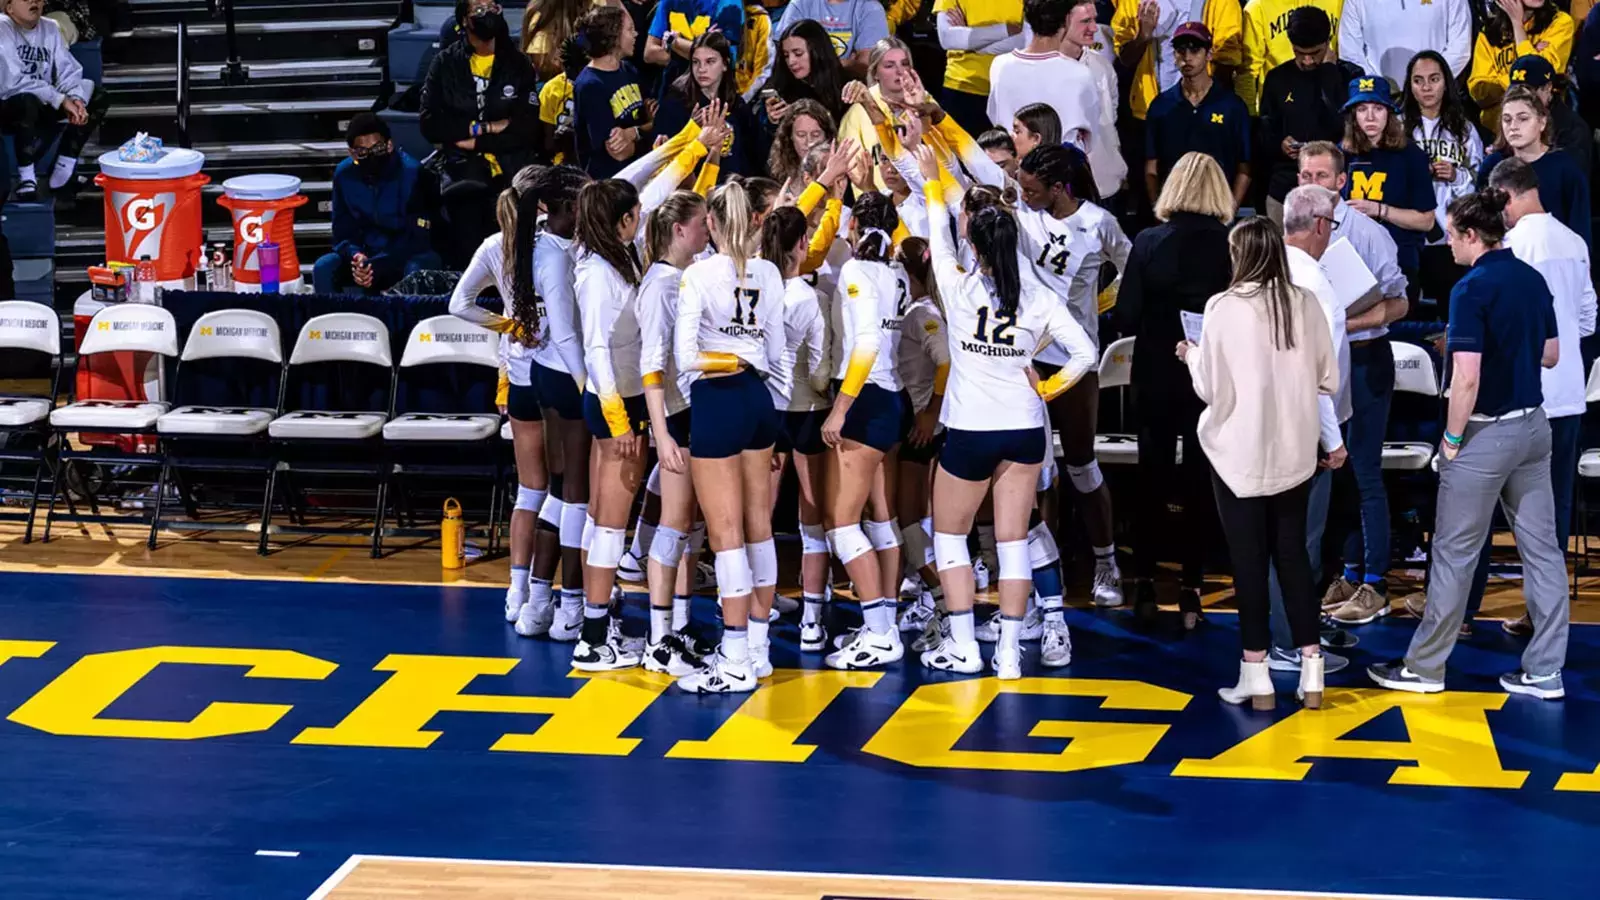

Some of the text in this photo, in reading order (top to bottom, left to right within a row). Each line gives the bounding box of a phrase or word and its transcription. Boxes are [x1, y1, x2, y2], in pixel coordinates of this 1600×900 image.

[1210, 112, 1224, 124] M
[1350, 170, 1388, 201] M
[127, 198, 155, 230] G
[240, 215, 263, 243] G
[1048, 231, 1067, 246] M
[1036, 243, 1070, 275] 14
[730, 286, 760, 325] 17
[200, 326, 213, 336] M
[309, 330, 321, 340] M
[419, 333, 432, 342] M
[973, 305, 1017, 346] 12
[0, 640, 1600, 792] CHIGA
